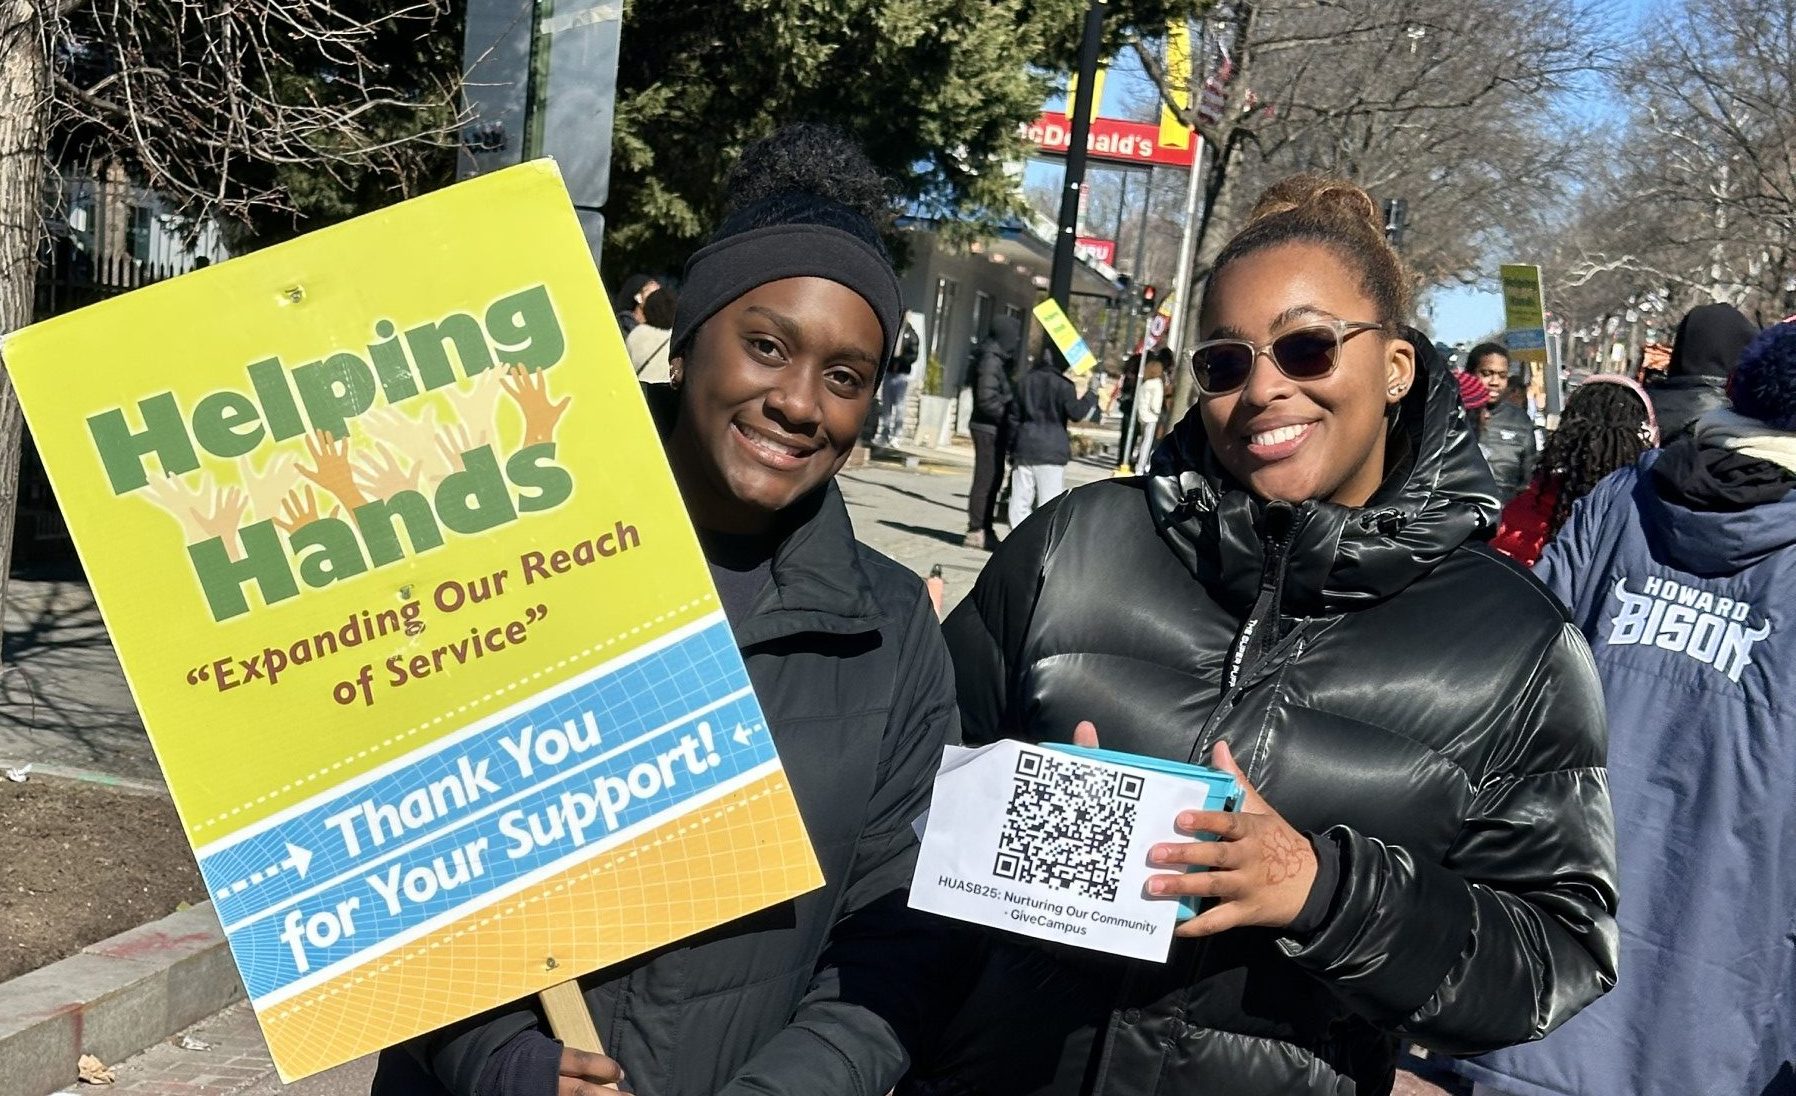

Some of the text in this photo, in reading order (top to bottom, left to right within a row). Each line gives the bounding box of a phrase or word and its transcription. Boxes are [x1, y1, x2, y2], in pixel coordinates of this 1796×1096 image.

[1016, 121, 1153, 157] cDnald's
[87, 284, 566, 496] Helping
[187, 442, 573, 623] Hands
[435, 569, 509, 615] Our
[519, 520, 641, 586] Reach
[1608, 577, 1771, 683] BISON
[1643, 576, 1751, 622] HOWARD
[332, 665, 375, 708] of
[324, 709, 602, 861] Thank You
[280, 720, 721, 973] for Your Support!
[938, 874, 1158, 935] HUASB25: Nurturing Our Community
[1010, 909, 1088, 936] GiveCampus
